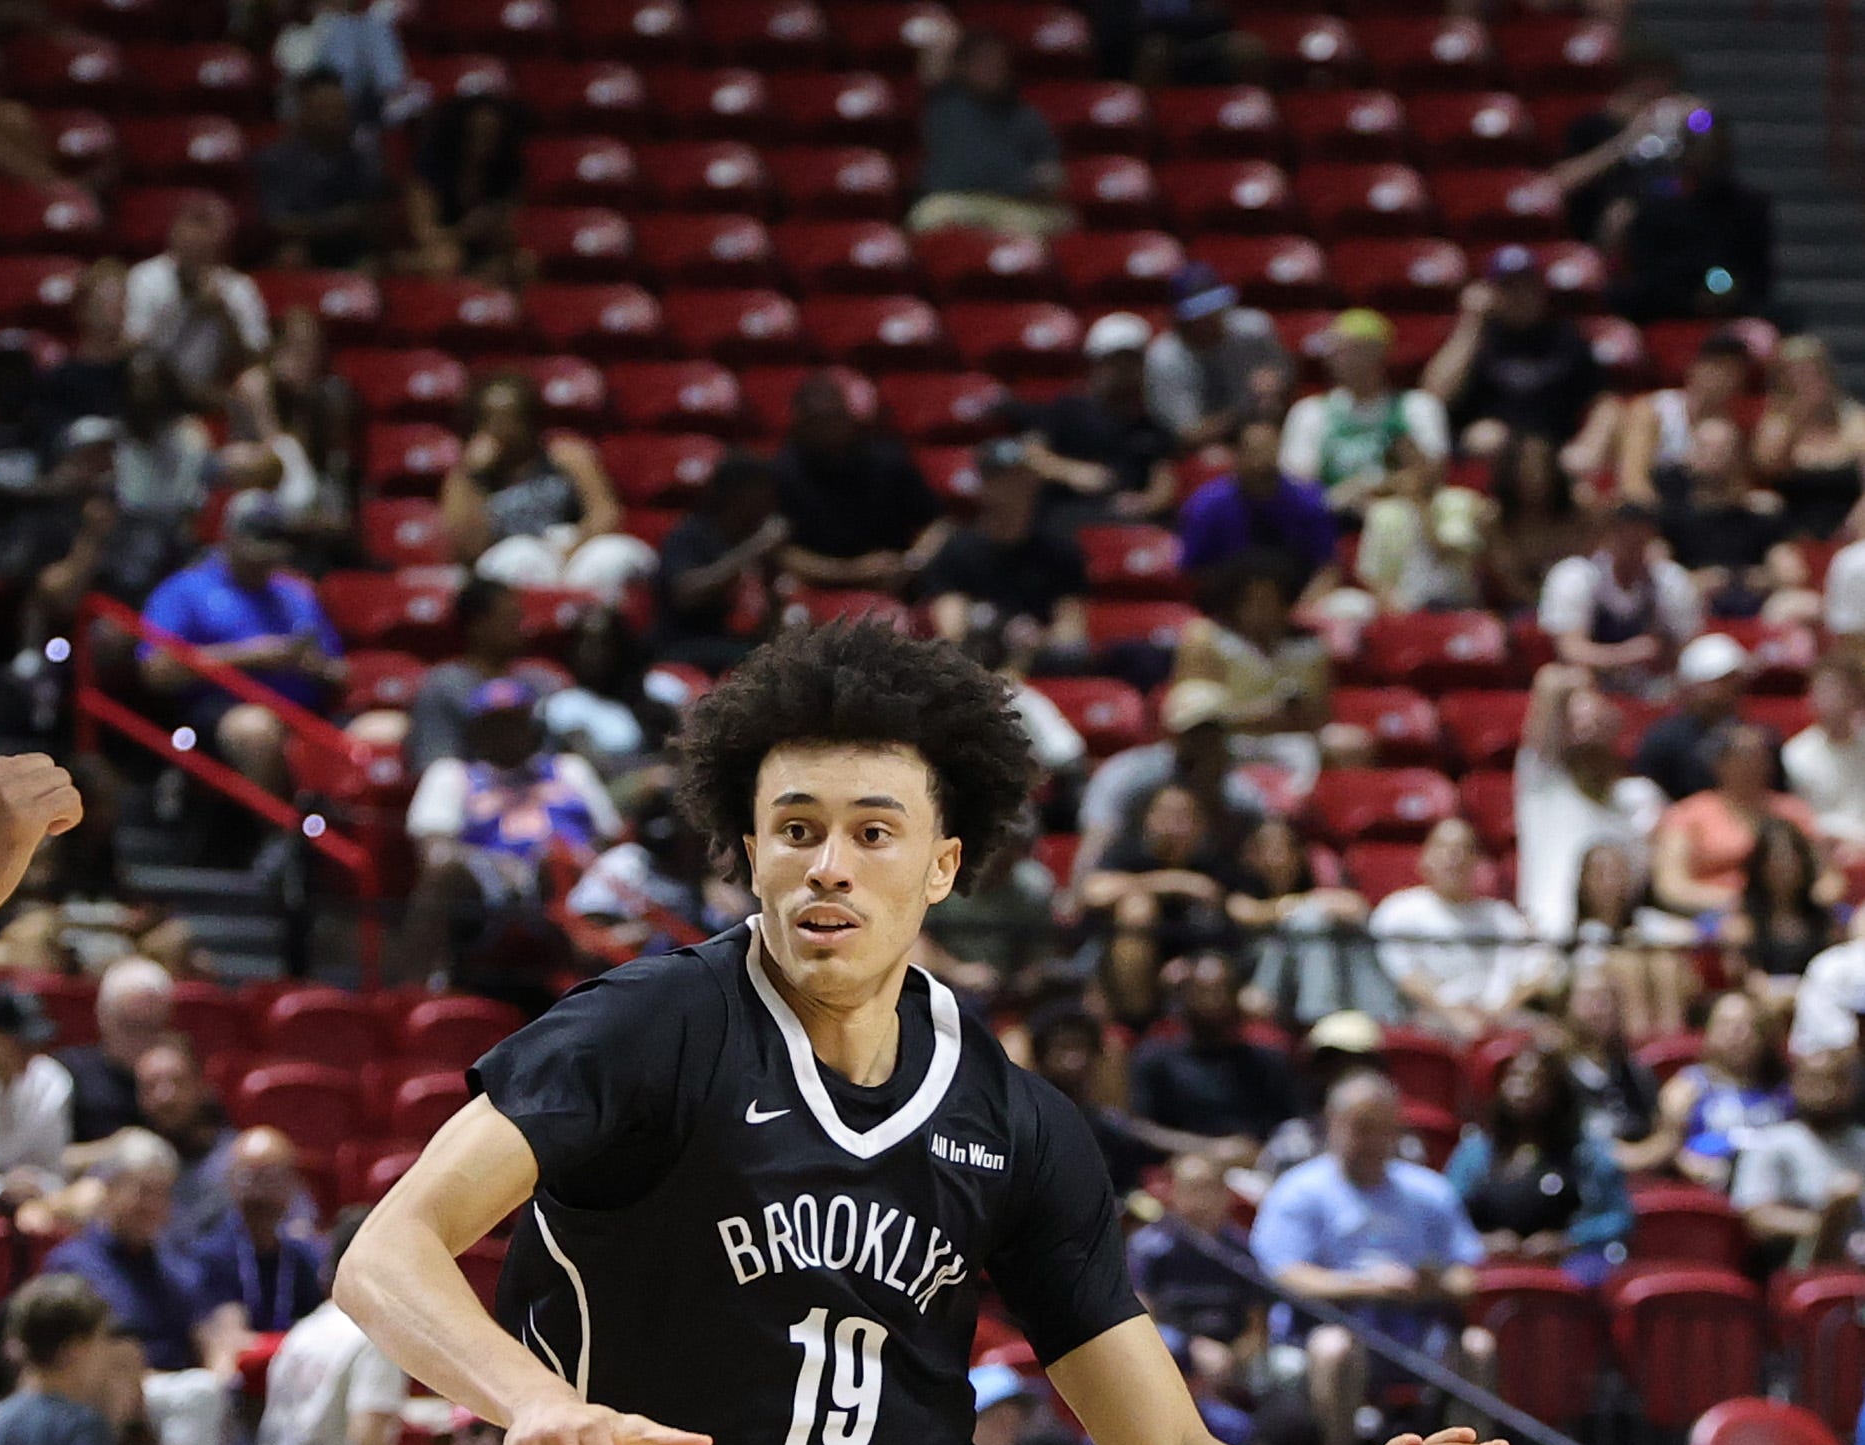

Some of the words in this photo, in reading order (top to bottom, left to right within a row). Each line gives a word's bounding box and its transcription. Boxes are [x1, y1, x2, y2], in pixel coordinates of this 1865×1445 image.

[931, 1133, 947, 1159] All
[949, 1140, 966, 1164] In
[969, 1142, 1005, 1171] Won
